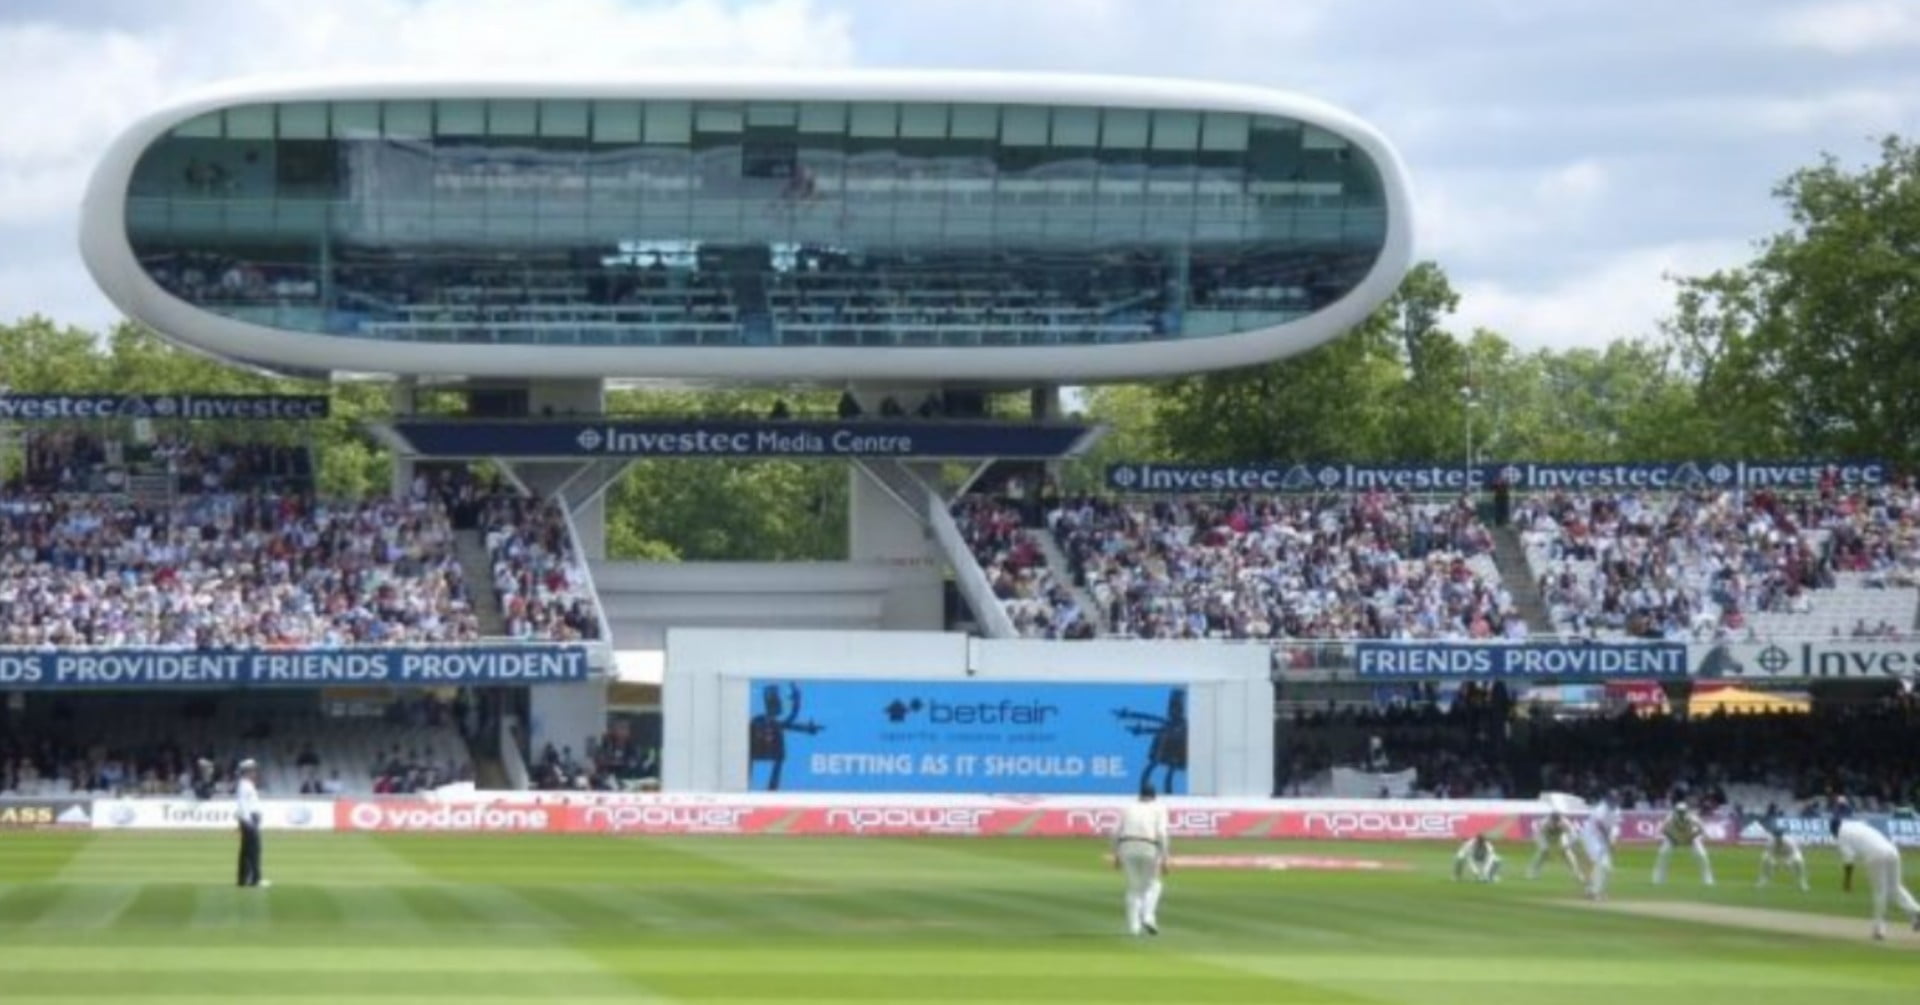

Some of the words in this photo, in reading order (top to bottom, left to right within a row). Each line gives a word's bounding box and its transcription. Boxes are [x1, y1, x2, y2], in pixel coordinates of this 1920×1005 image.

[183, 396, 323, 417] Investec
[606, 428, 750, 451] Investec
[757, 430, 823, 451] Media
[832, 430, 912, 451] Centre
[1141, 465, 1280, 488] Investec
[1346, 464, 1485, 487] Investec
[1528, 464, 1668, 486] Investec
[0, 657, 42, 680] DS
[57, 655, 242, 680] PROVIDENT
[252, 653, 388, 679] FRIENDS
[402, 651, 582, 679] PROVIDENT
[1360, 649, 1492, 673] FRIENDS
[1504, 647, 1683, 673] PROVIDENT
[929, 698, 1059, 725] betfair
[811, 752, 912, 775] BETTING
[920, 754, 949, 775] AS
[956, 754, 976, 776] IT
[984, 754, 1083, 777] SHOULD
[1091, 756, 1127, 778] BE.
[388, 805, 549, 829] vodafone
[585, 806, 754, 831] npower
[827, 808, 996, 834] npower
[1066, 809, 1233, 835] nper
[1303, 812, 1468, 835] npower
